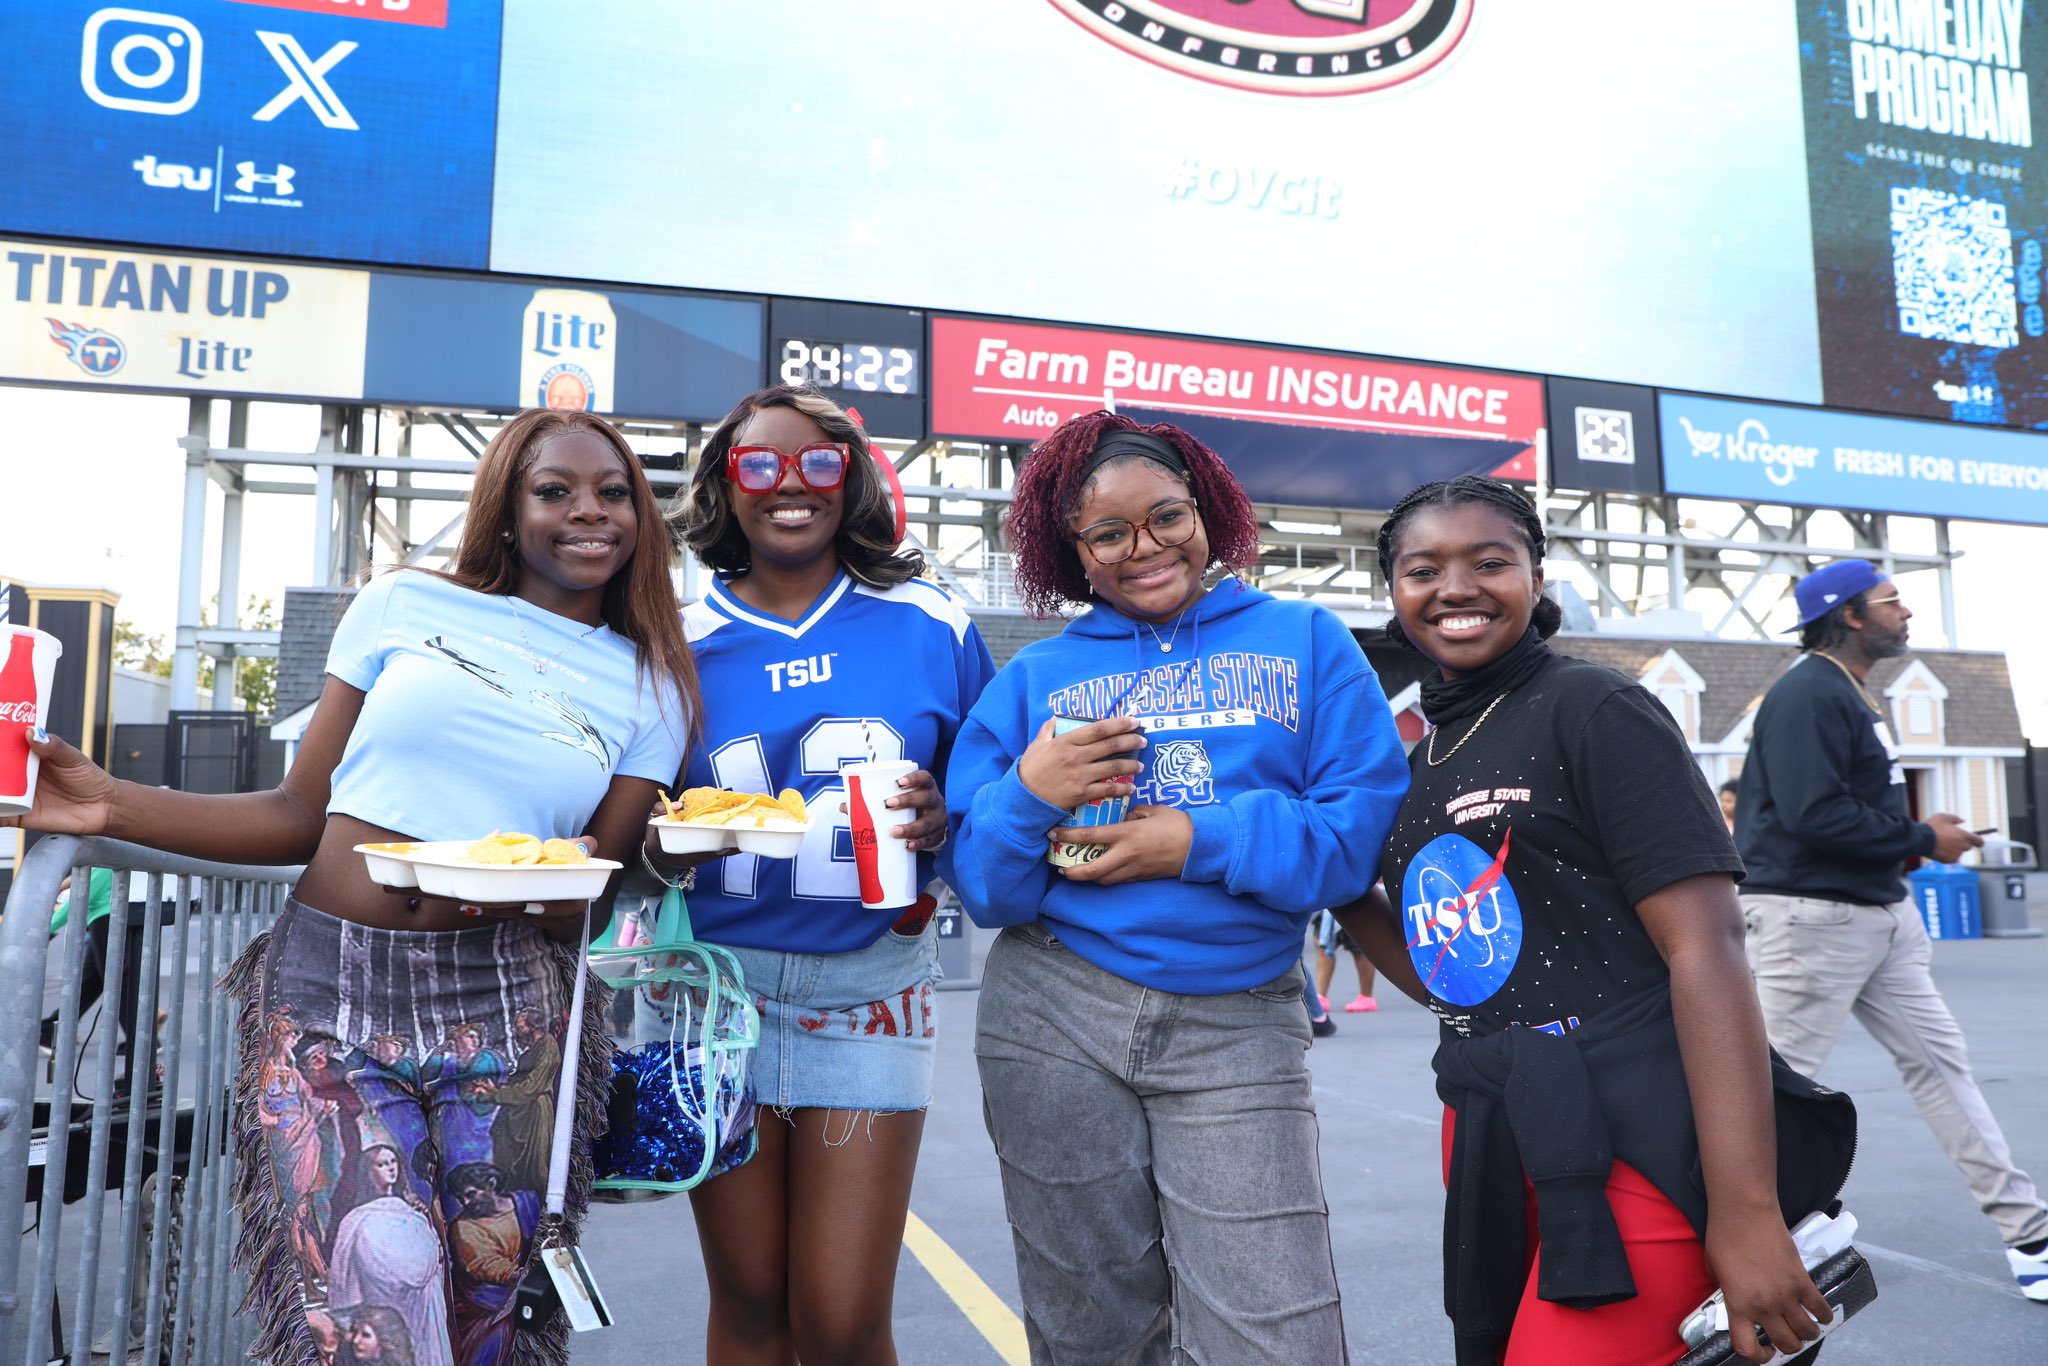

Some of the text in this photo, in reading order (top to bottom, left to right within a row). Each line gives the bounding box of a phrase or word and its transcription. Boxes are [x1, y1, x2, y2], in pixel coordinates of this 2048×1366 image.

[1103, 3, 1413, 75] ONFERENCE
[1850, 40, 2033, 148] PROGRAM
[1866, 142, 2024, 182] SCAN THE QR CODE
[7, 251, 289, 319] TITAN UP
[175, 336, 253, 380] Lite
[534, 311, 605, 357] Lite
[780, 340, 913, 393] 24:22
[974, 338, 1507, 425] Farm Bureau INSURANCE
[1003, 403, 1059, 427] Auto
[1726, 418, 1818, 486] Kroger
[1834, 447, 2048, 491] FRESH FOR EVERYO
[1048, 652, 1299, 734] TENNESSEE STATE
[1153, 711, 1237, 729] GERS
[1446, 788, 1531, 815] TENNESSEE STATE
[1454, 803, 1506, 826] UNIVERSITY
[1408, 887, 1501, 948] TSU
